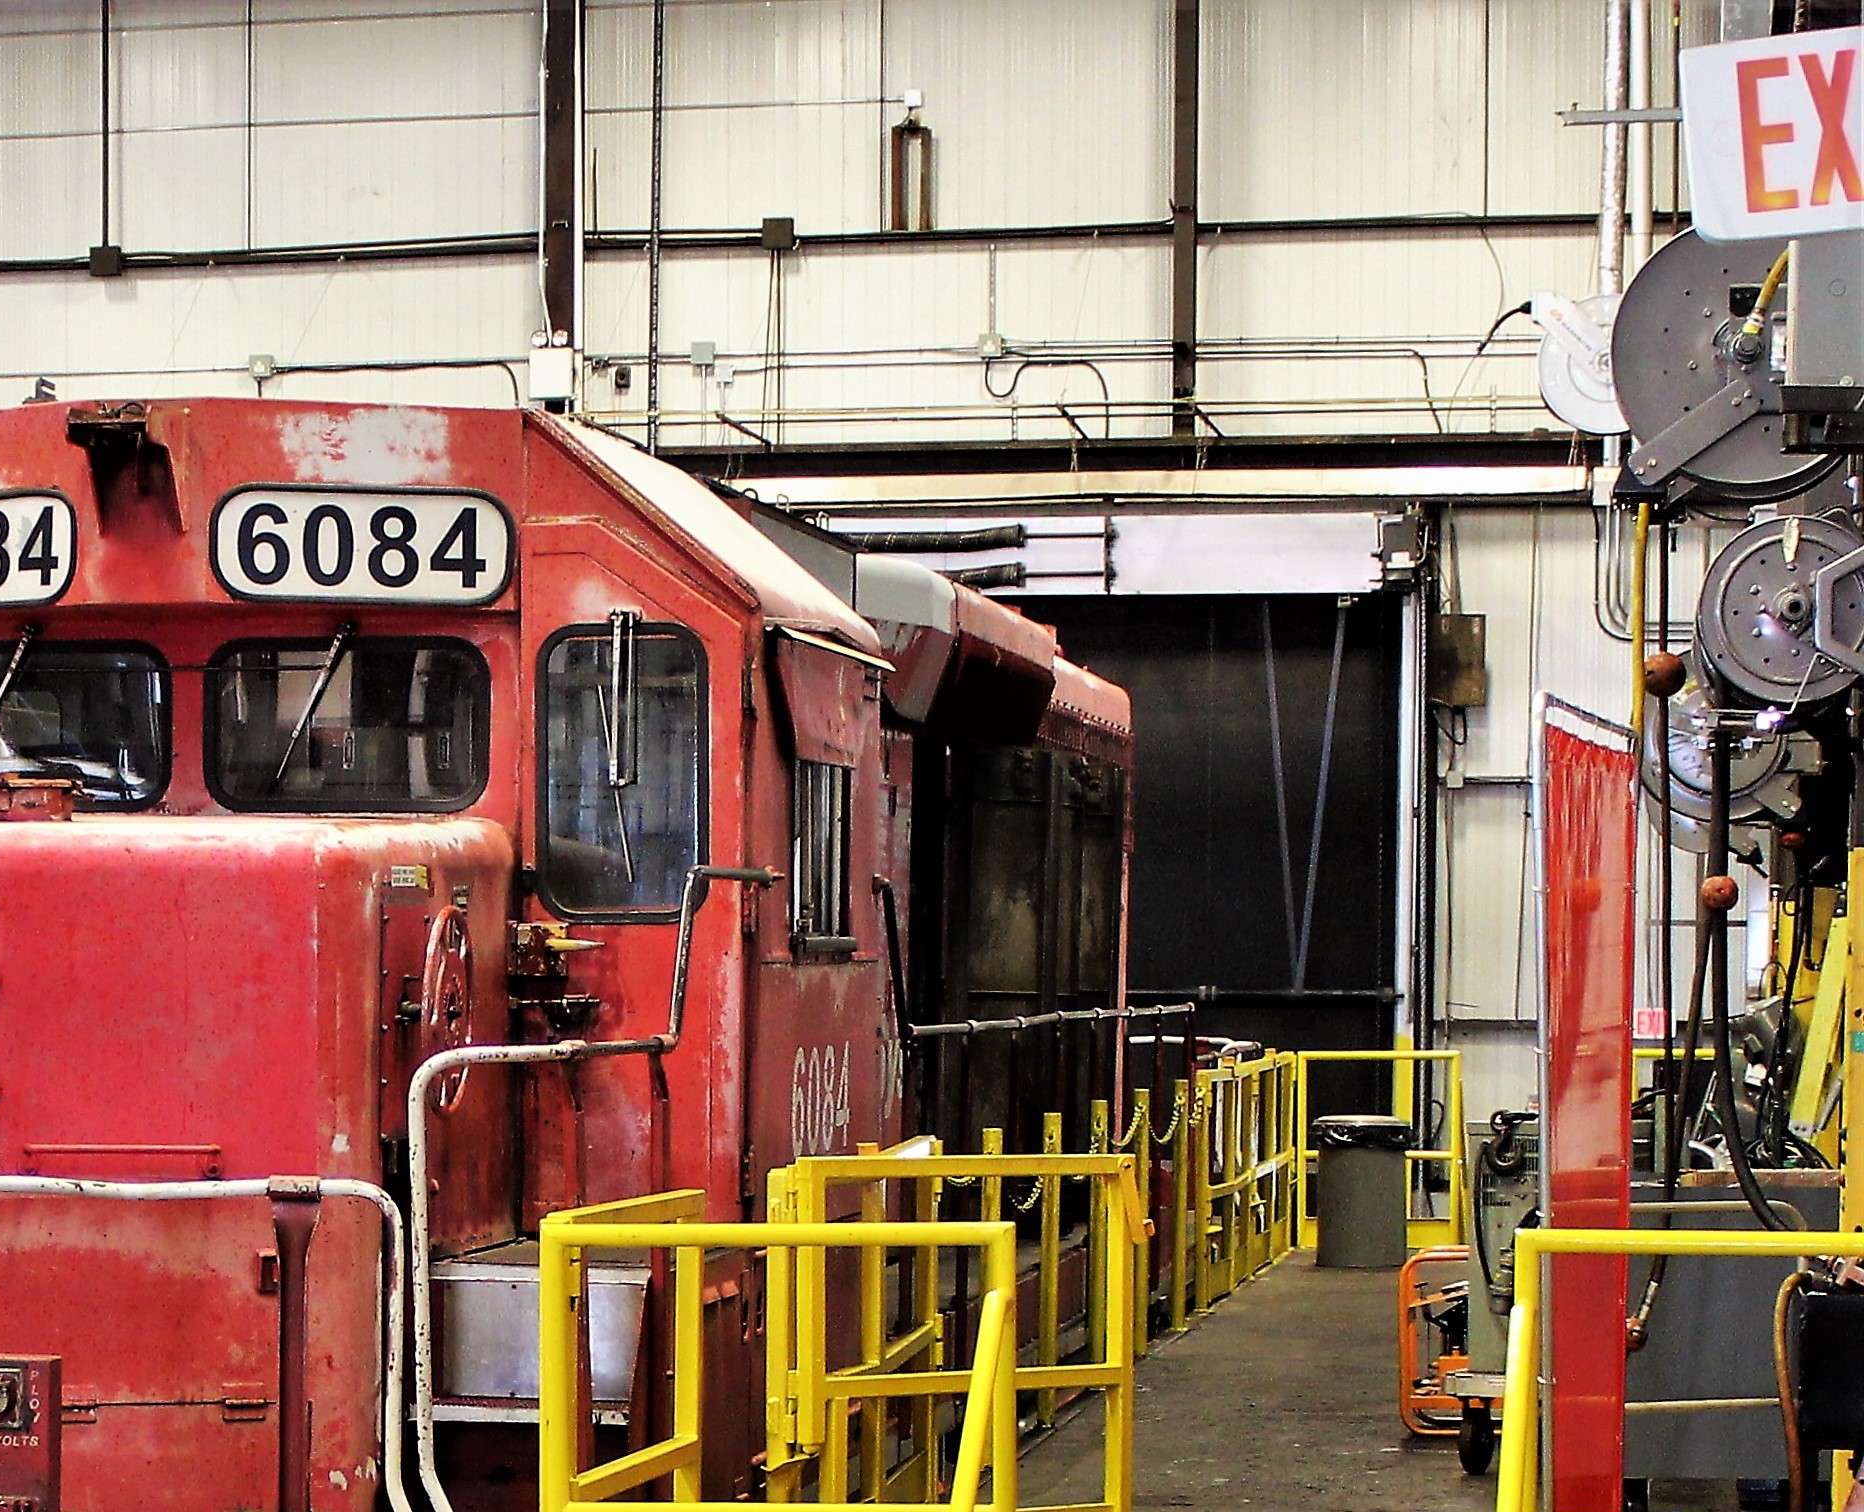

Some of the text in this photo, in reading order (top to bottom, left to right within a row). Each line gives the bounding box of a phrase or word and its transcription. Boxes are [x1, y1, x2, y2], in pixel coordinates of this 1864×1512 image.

[1736, 49, 1864, 213] EX
[237, 503, 487, 589] 6084
[1637, 1010, 1665, 1036] EXI
[792, 1040, 850, 1156] 6084
